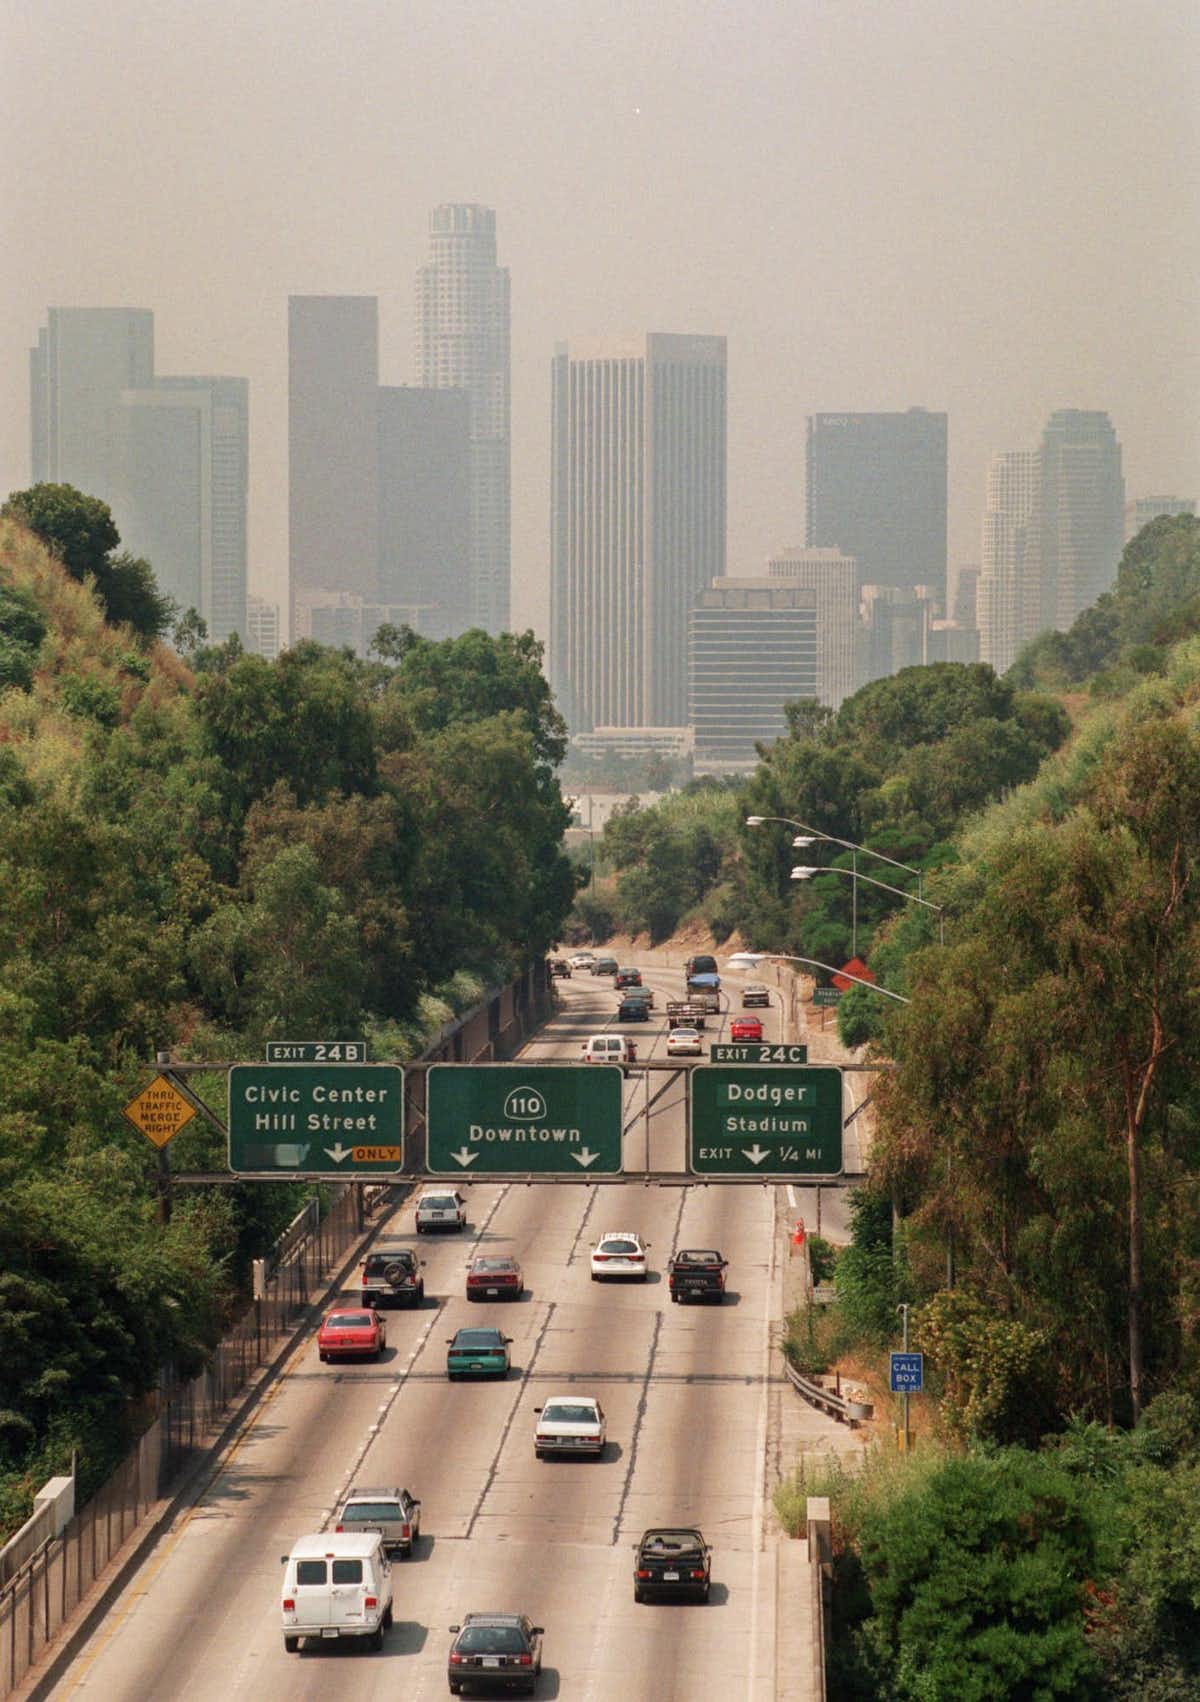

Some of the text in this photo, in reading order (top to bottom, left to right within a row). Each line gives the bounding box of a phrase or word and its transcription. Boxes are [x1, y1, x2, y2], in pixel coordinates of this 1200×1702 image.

[273, 1045, 358, 1061] EXIT 24B
[716, 1046, 801, 1062] EXIT 24C
[147, 1091, 175, 1100] THRU
[244, 1085, 388, 1103] Civic Center
[727, 1083, 807, 1107] Dodger
[140, 1102, 182, 1111] TRAFFIC
[511, 1097, 540, 1113] 110
[140, 1113, 181, 1122] MERGE
[255, 1113, 377, 1130] Hill Street
[144, 1124, 177, 1132] RIGHT
[726, 1117, 807, 1132] Stadium
[469, 1124, 580, 1141] Downtown
[356, 1149, 396, 1159] ONLY
[699, 1148, 733, 1159] EXIT
[806, 1149, 822, 1160] MI
[893, 1362, 920, 1372] CALL
[896, 1374, 917, 1383] BOX
